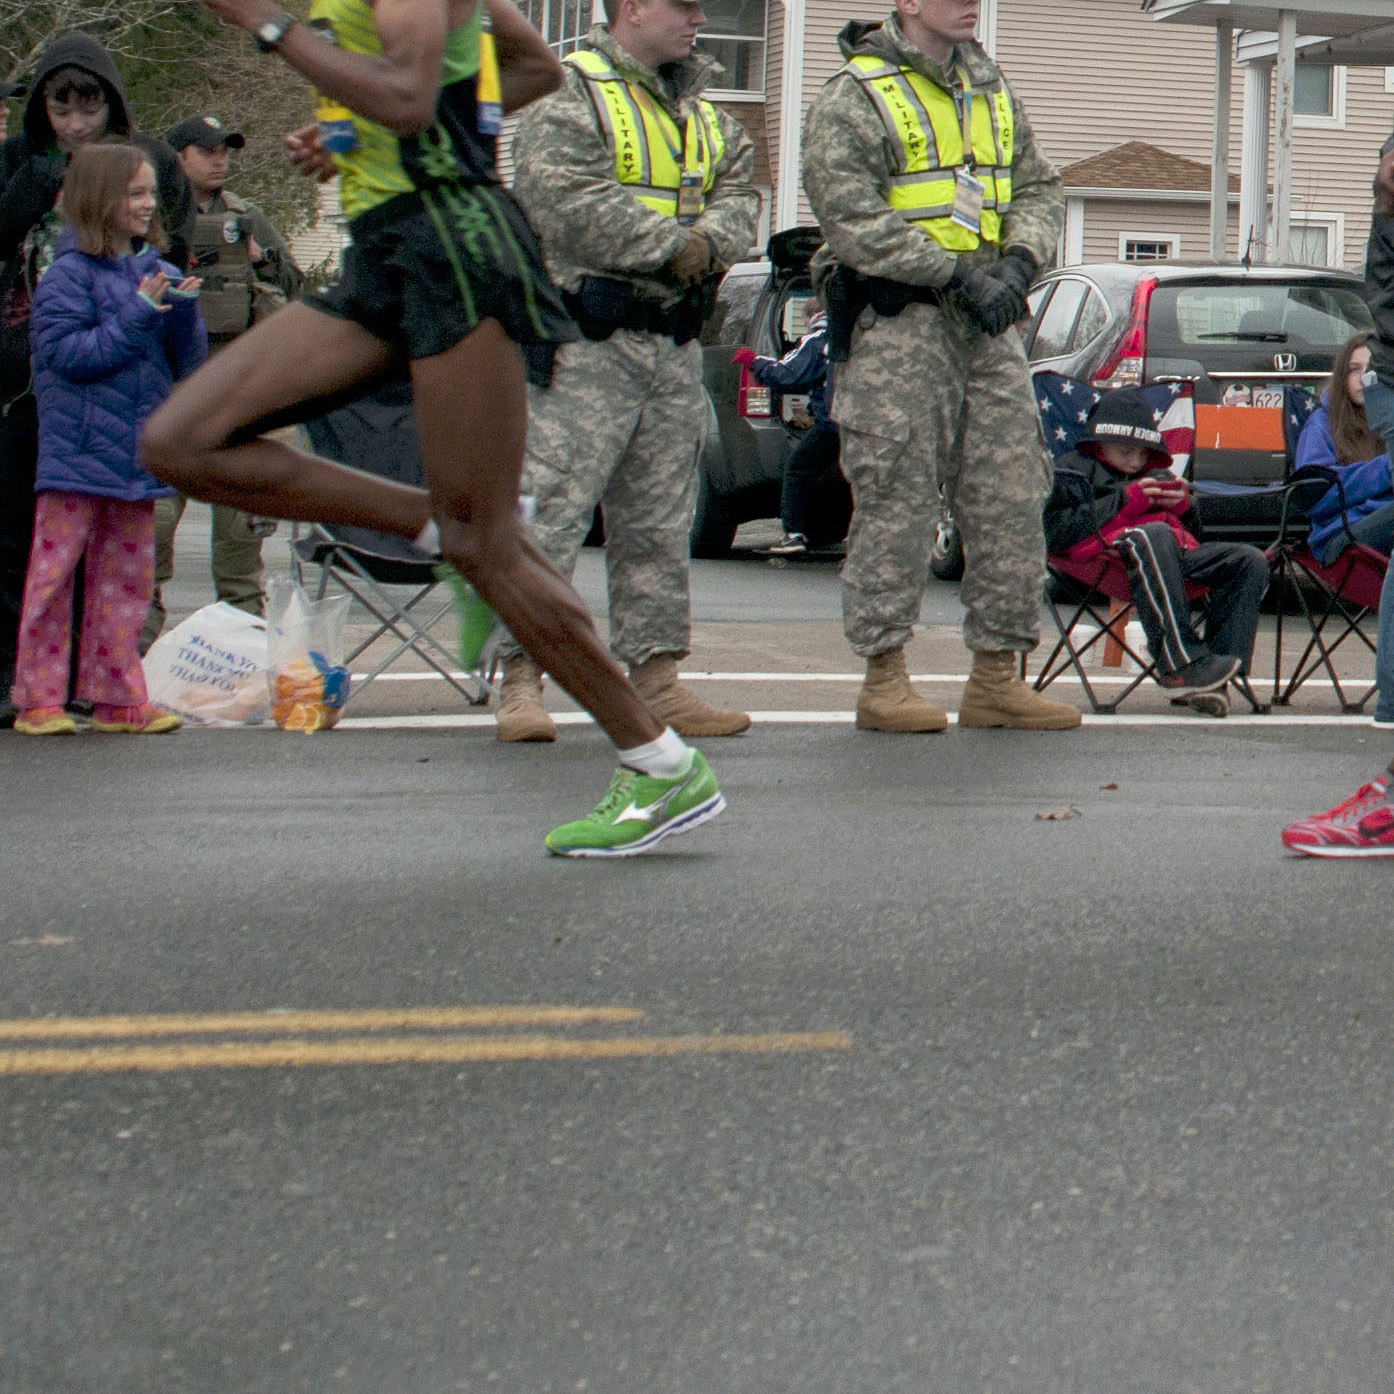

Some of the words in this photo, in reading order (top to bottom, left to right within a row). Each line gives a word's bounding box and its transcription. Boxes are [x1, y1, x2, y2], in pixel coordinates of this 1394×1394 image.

[883, 84, 921, 158] MILITARY
[1255, 392, 1282, 407] 622
[1095, 423, 1134, 438] ARMOUR
[1134, 426, 1162, 444] UNDER
